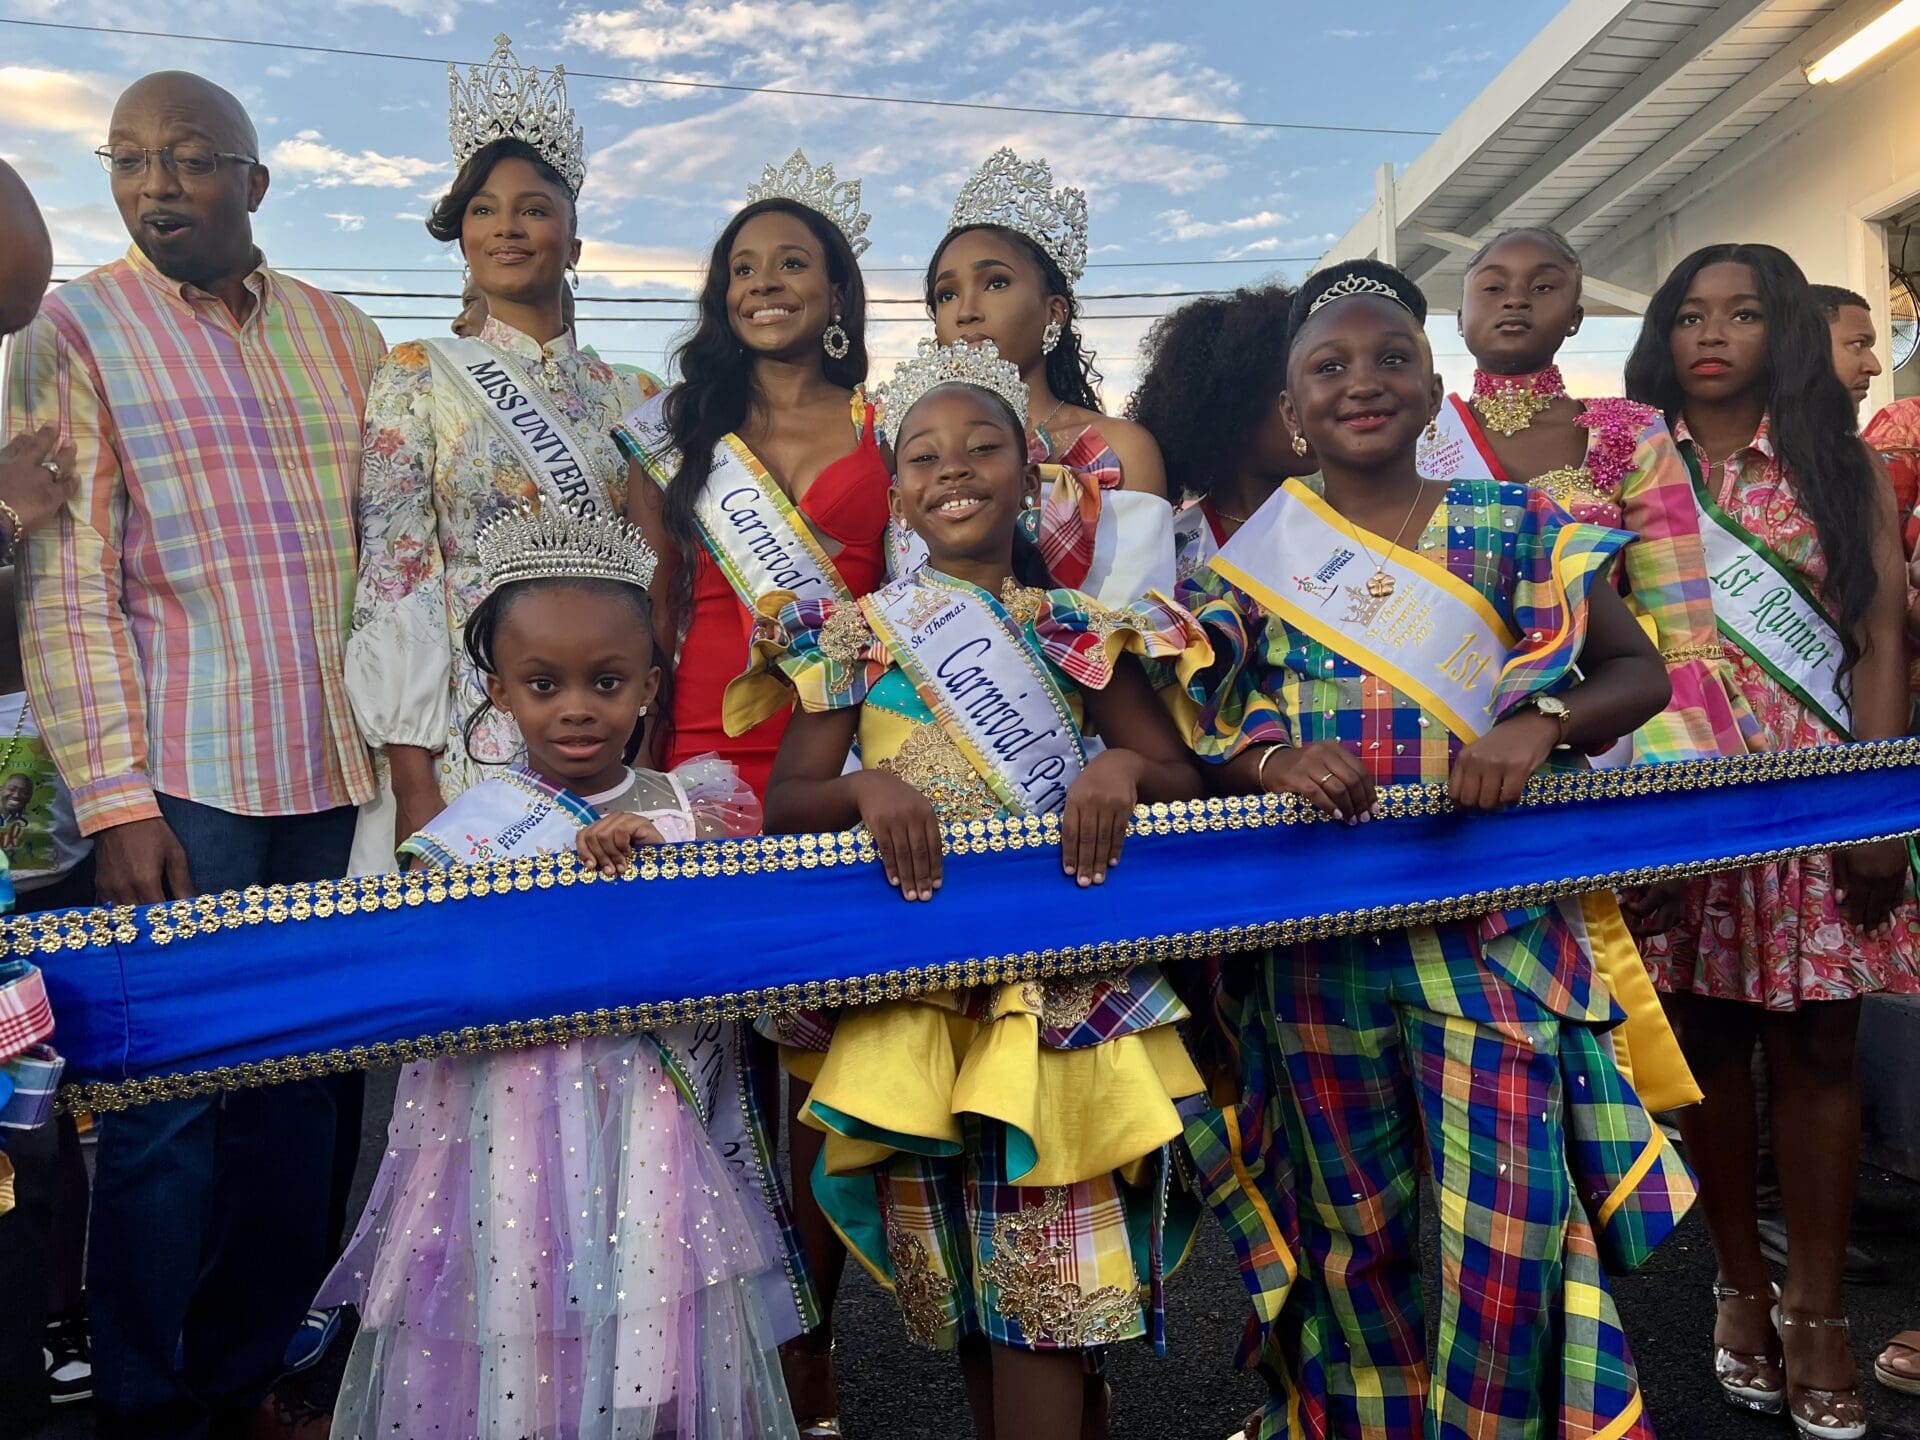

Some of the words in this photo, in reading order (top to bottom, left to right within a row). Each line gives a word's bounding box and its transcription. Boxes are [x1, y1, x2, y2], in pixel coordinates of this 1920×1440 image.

[467, 360, 528, 411] MISS
[1423, 446, 1461, 472] Carnival
[1429, 438, 1464, 460] Thomas
[1442, 454, 1465, 469] Miss
[1440, 464, 1461, 479] 2025
[721, 487, 821, 591] Carnival
[1316, 555, 1343, 581] DIVISION
[1322, 551, 1356, 584] FESTIVALS
[1710, 553, 1764, 598] 1st
[911, 632, 927, 650] St.
[924, 601, 968, 641] Thomas
[1436, 633, 1492, 692] 1st
[936, 637, 1057, 762] Carnival
[497, 814, 536, 845] DIVISION
[503, 805, 552, 851] FESTIVALS
